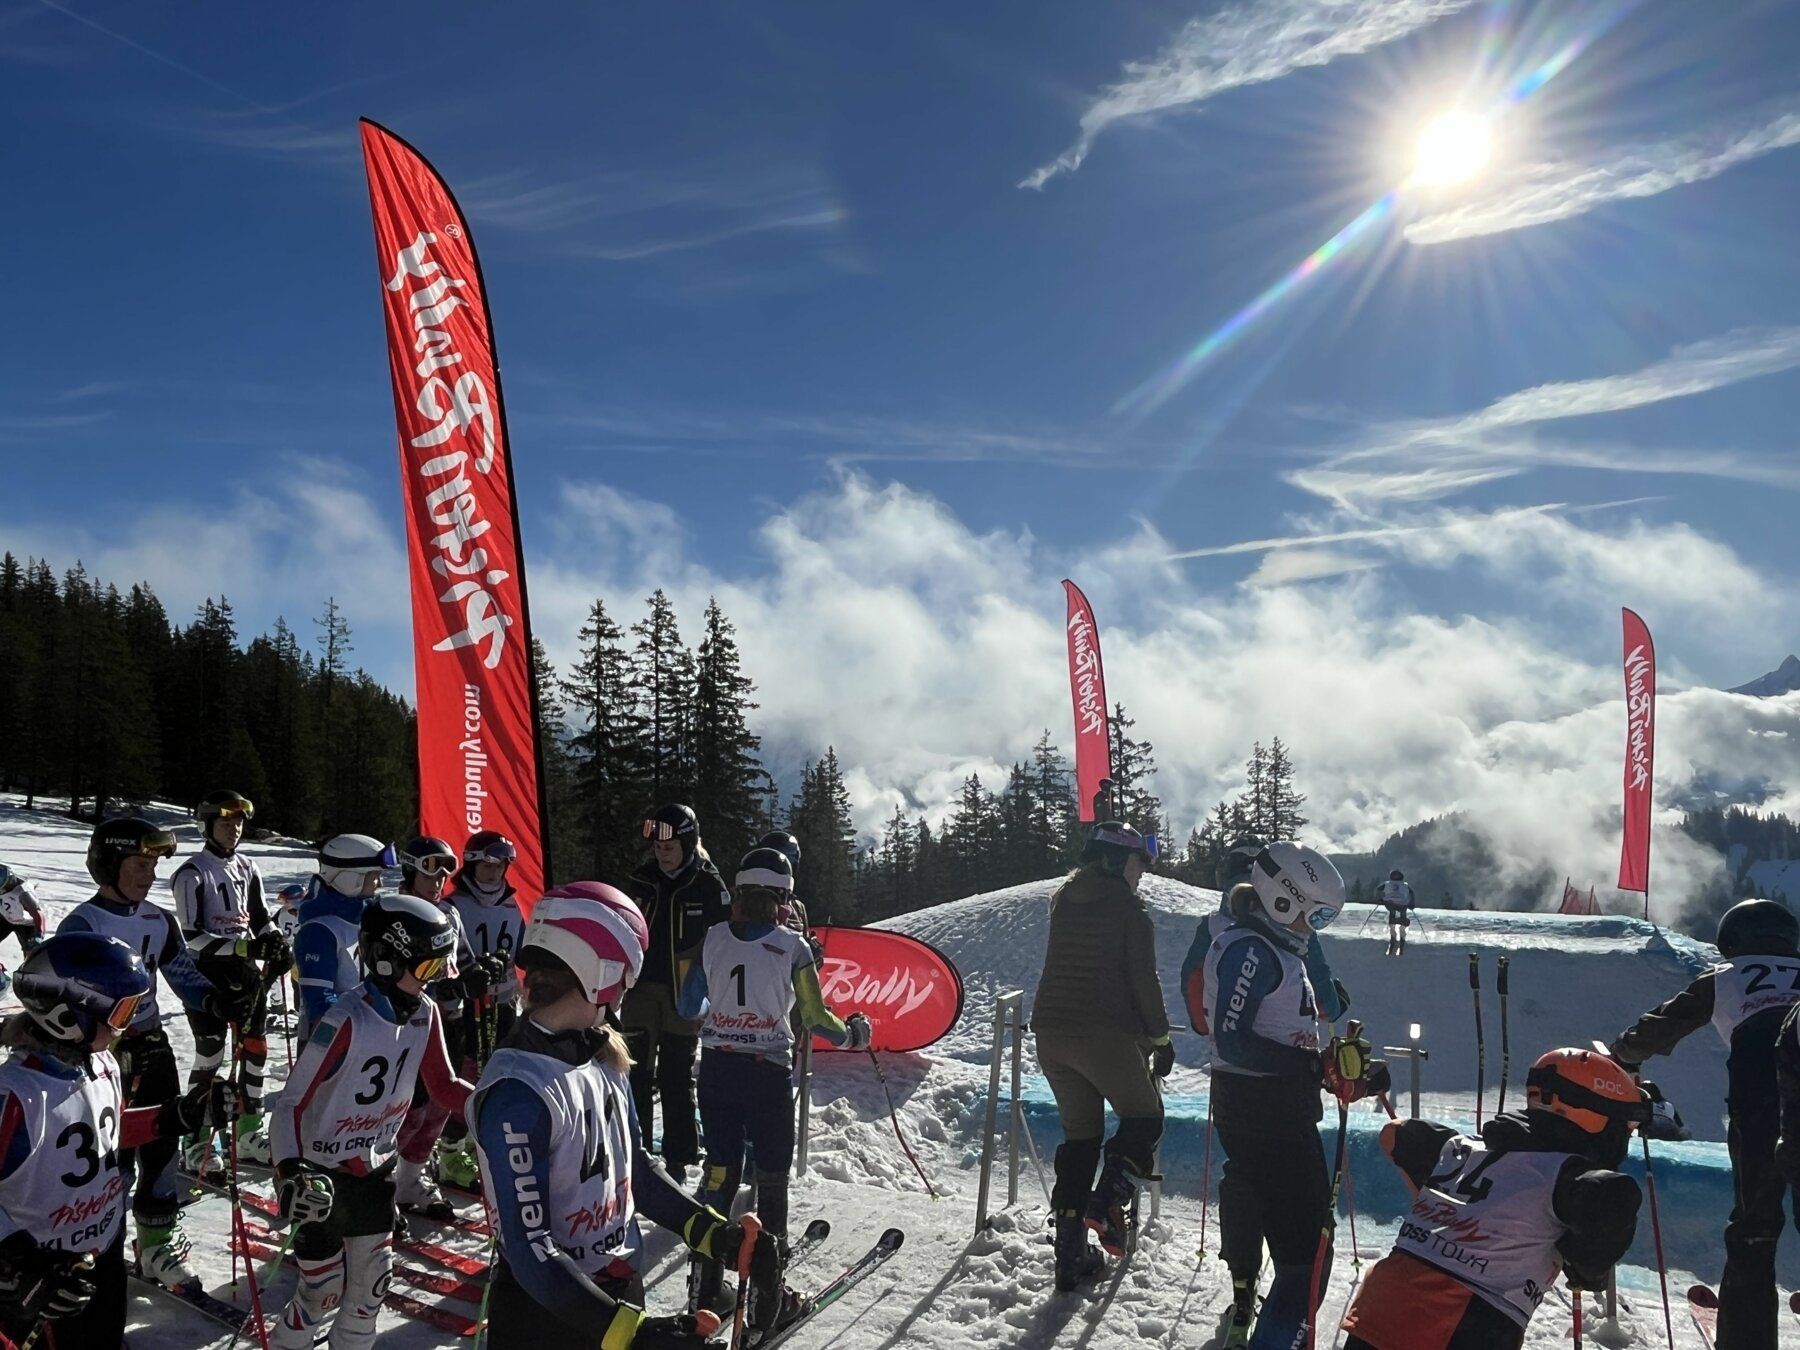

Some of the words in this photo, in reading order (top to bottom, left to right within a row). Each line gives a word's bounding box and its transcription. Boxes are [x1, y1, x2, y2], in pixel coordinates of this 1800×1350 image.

[475, 920, 513, 954] 16
[730, 964, 746, 1006] 1
[823, 957, 934, 1020] Bully
[1741, 963, 1800, 995] 27
[355, 1047, 410, 1105] 31
[56, 1106, 117, 1188] 32
[312, 1140, 340, 1155] SKI
[1523, 1278, 1544, 1306] SK
